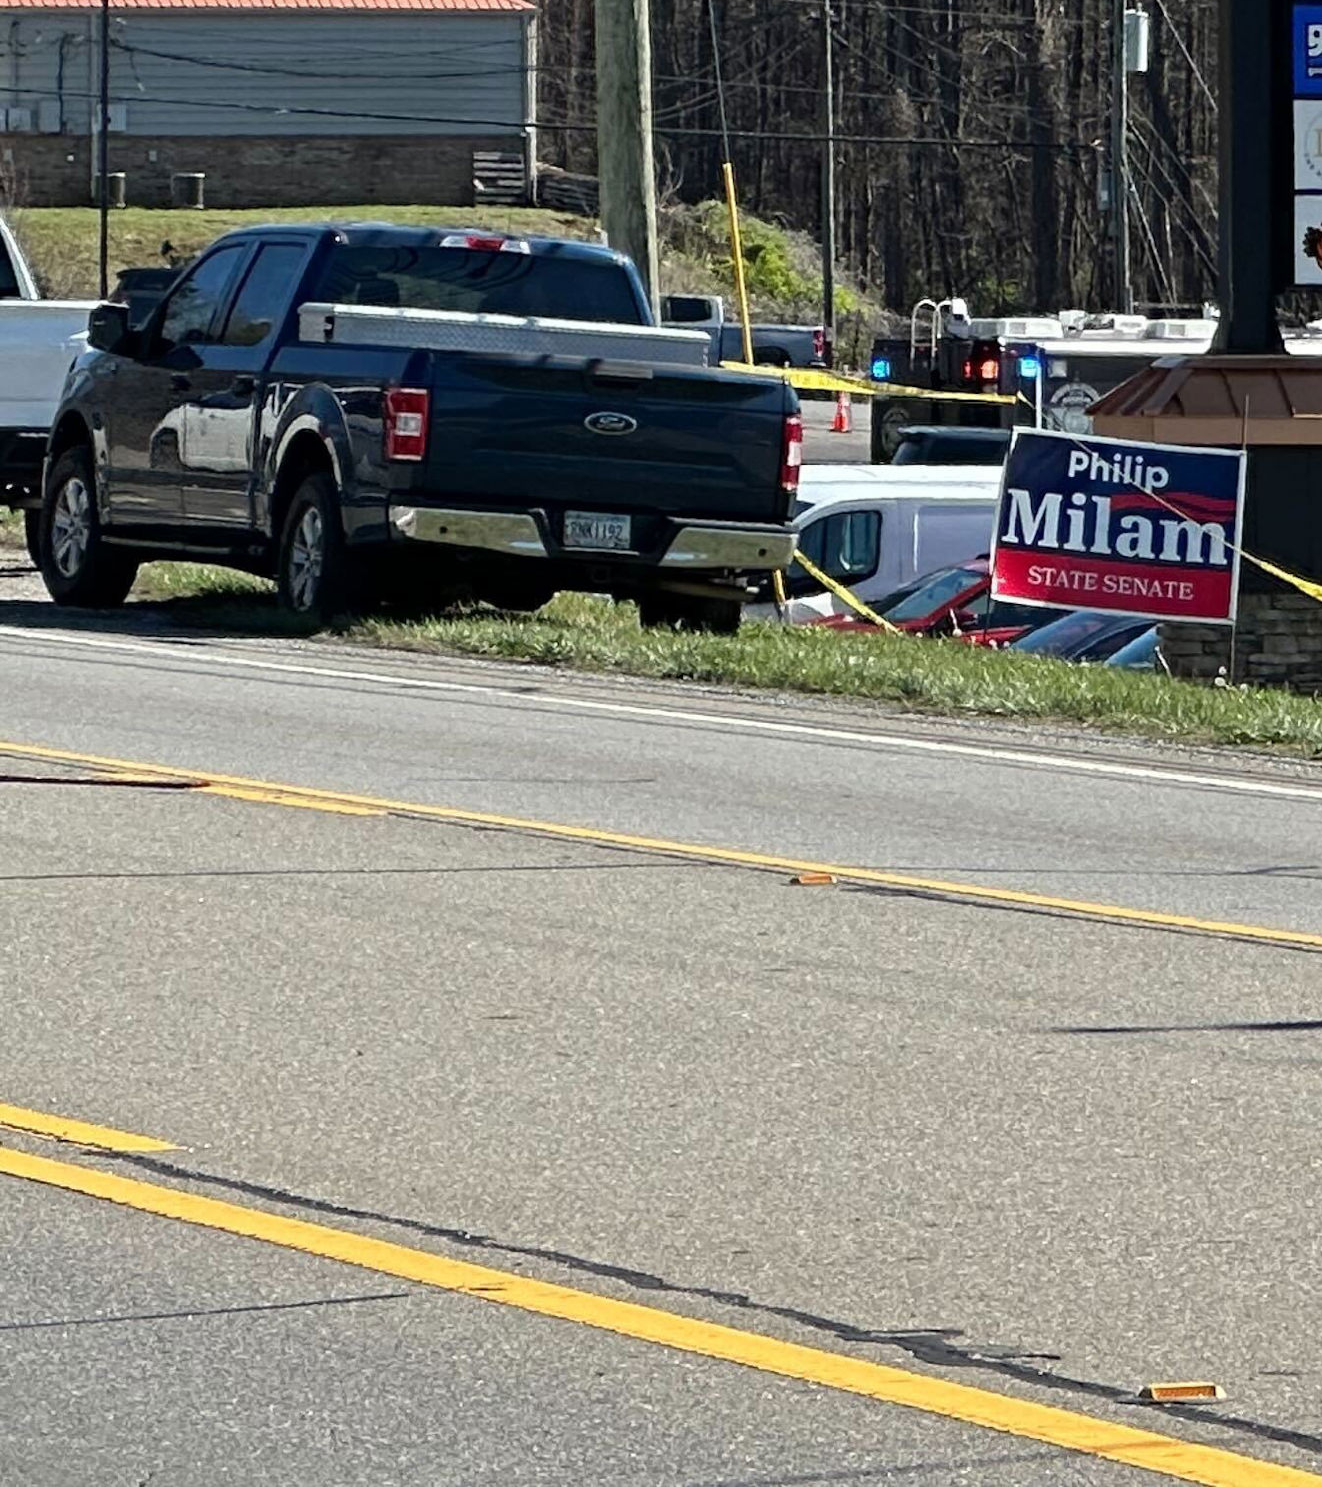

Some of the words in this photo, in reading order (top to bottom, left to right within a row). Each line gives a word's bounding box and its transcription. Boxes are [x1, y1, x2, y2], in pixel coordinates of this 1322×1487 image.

[1068, 449, 1170, 494] Philip
[1001, 488, 1228, 565] Milam
[1027, 566, 1098, 591] STATE
[1102, 574, 1194, 601] SENATE
